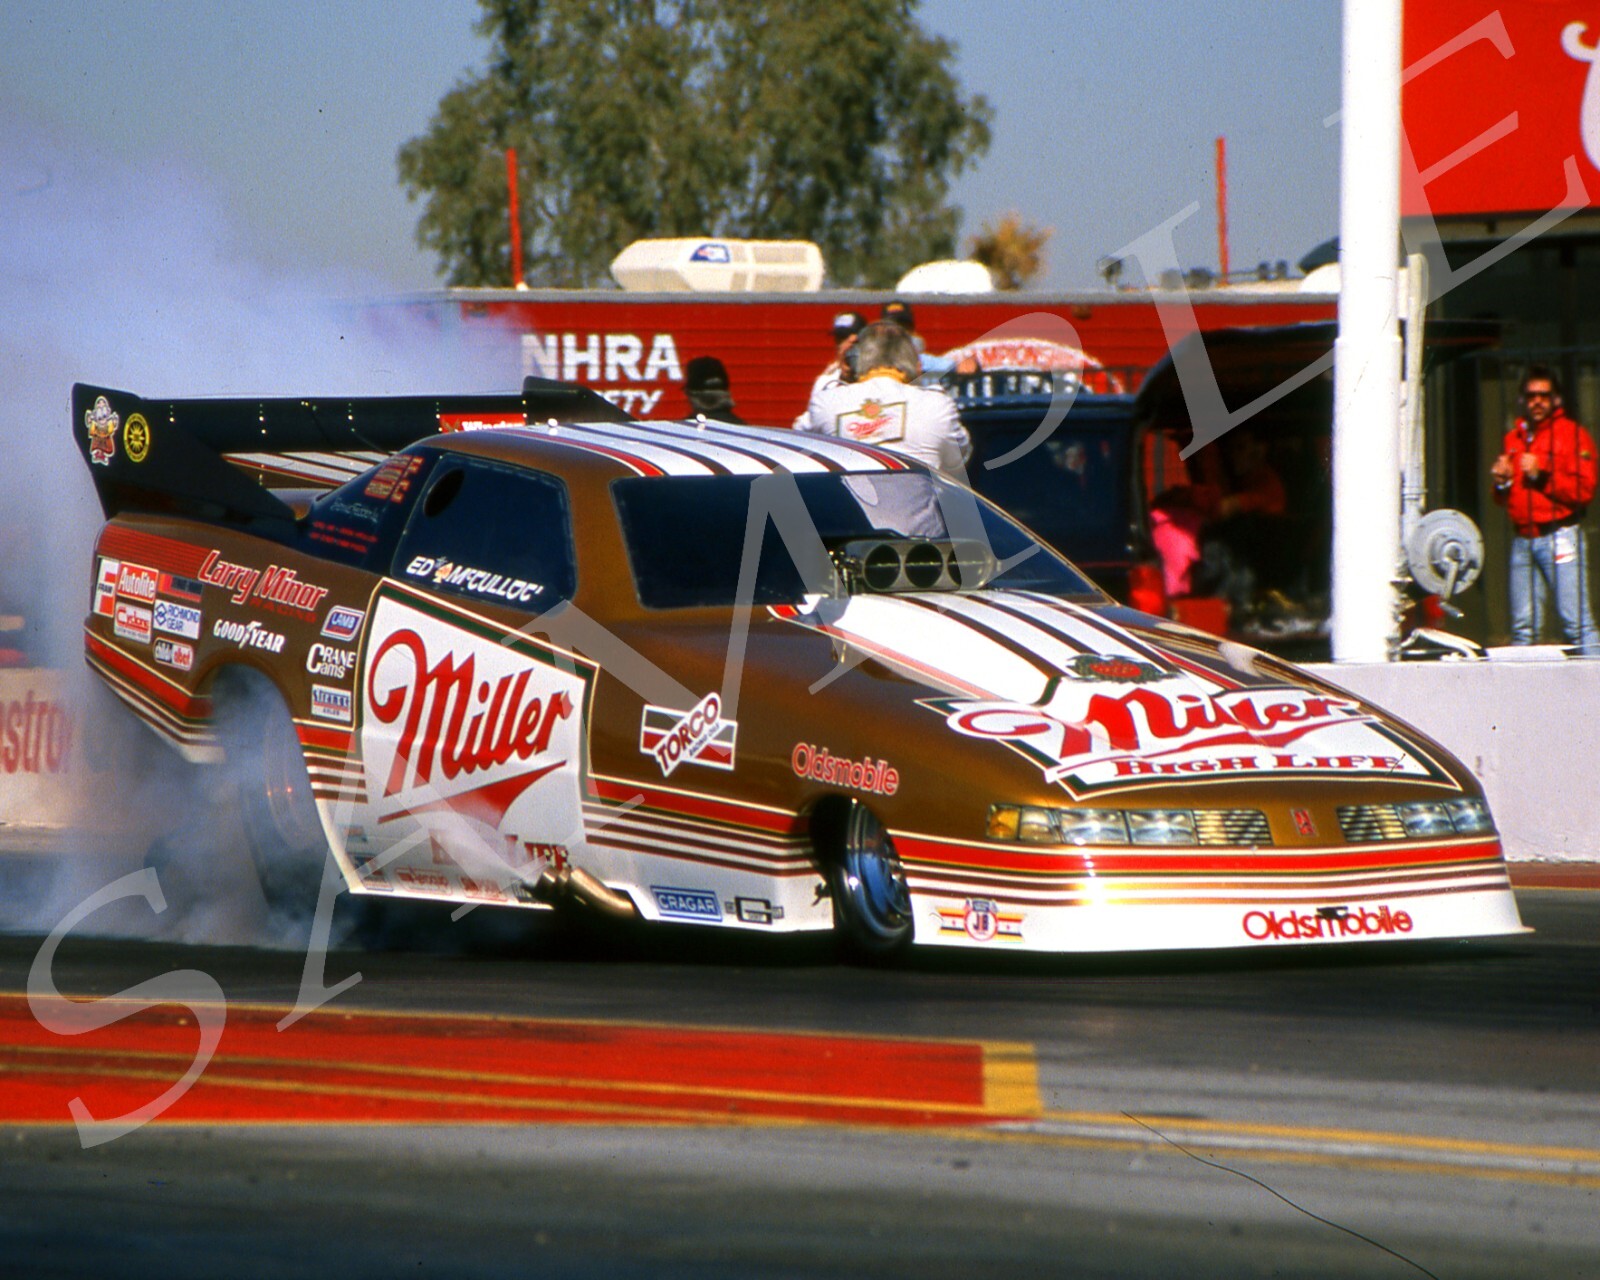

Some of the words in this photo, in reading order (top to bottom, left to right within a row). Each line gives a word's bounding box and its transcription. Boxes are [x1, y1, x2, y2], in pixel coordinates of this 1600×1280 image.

[520, 333, 684, 381] NHRA
[118, 566, 156, 599] Autolite
[198, 550, 260, 605] Larry
[253, 565, 329, 611] Minor
[406, 556, 435, 576] ED
[167, 617, 184, 631] GEAR
[168, 604, 201, 623] RICHMOND
[213, 619, 285, 653] GOODYEAR
[306, 643, 356, 674] CRANE
[368, 628, 574, 798] Miller
[958, 687, 1350, 759] Miller
[657, 697, 719, 772] TORCO
[792, 742, 899, 796] Oldsmobile
[1111, 755, 1258, 778] HIGH
[1272, 752, 1405, 771] LIFE
[658, 894, 717, 914] CRAGAR
[1242, 905, 1413, 940] Oldsmobile
